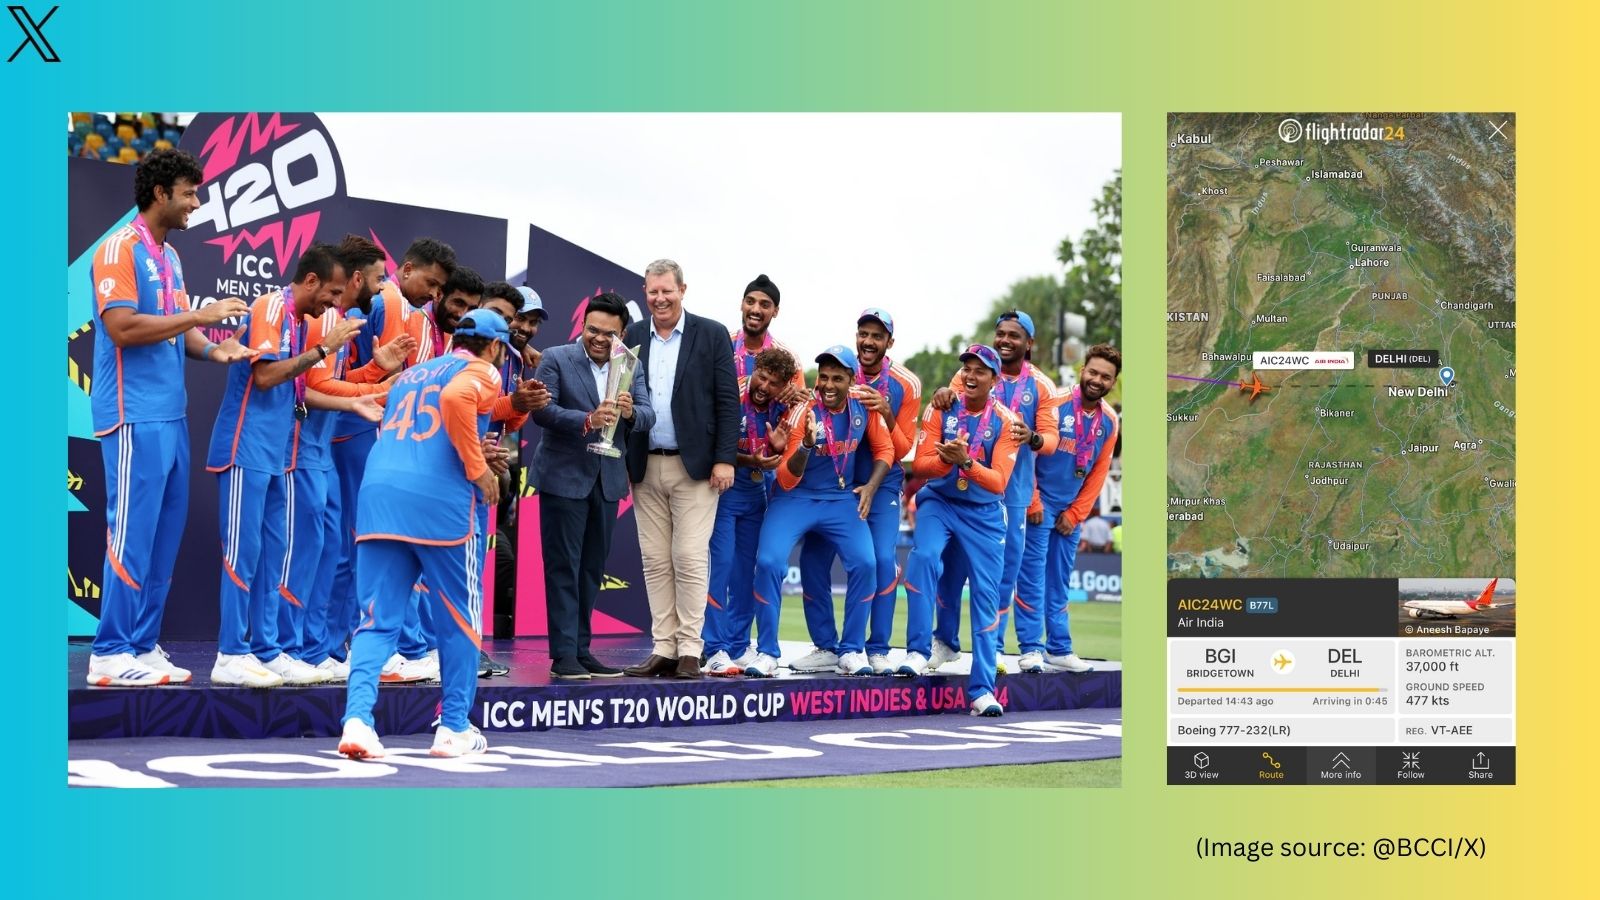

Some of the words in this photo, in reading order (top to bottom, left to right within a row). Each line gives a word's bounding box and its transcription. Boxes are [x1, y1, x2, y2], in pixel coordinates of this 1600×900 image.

[1177, 133, 1211, 144] Kabul
[1305, 122, 1405, 144] flightradar24
[1259, 157, 1304, 167] Peshawar
[1447, 153, 1471, 170] Indus
[1311, 169, 1363, 180] Islamabad
[1202, 186, 1228, 196] Khost
[1251, 191, 1268, 216] Indus
[1351, 243, 1402, 254] Gujranwala
[236, 253, 274, 279] ICC
[1355, 257, 1390, 267] Lahore
[1257, 272, 1306, 283] Faisalabad
[1371, 291, 1408, 300] PUNJAB
[1440, 301, 1494, 311] Chandigarh
[1167, 312, 1209, 322] KISTAN
[1256, 314, 1288, 323] Multan
[1202, 352, 1252, 362] Bahawalpu
[1260, 355, 1310, 366] AIC24WC
[1375, 354, 1407, 364] DELHI
[1408, 355, 1431, 364] (DEL)
[1388, 386, 1415, 397] New
[1417, 386, 1448, 397] Delhi
[383, 384, 441, 441] 45
[1320, 408, 1355, 418] Bikaner
[1493, 400, 1516, 418] Gang
[1167, 412, 1198, 422] Sukkur
[1408, 443, 1439, 455] Jaipur
[1453, 440, 1477, 452] Agra
[1308, 460, 1363, 469] RAJASTHAN
[1310, 476, 1349, 487] Jodhpur
[1170, 497, 1201, 507] Mirpur
[1203, 497, 1226, 506] Khas
[1167, 511, 1204, 521] erabad
[1333, 541, 1369, 553] Udaipur
[1177, 598, 1243, 612] AIC24WC
[1249, 600, 1274, 610] B77L
[1177, 617, 1194, 628] Air
[1196, 617, 1224, 628] India
[1204, 648, 1237, 664] BGI
[1327, 648, 1363, 664] DEL
[1405, 648, 1472, 658] BAROMETRIC
[1473, 648, 1496, 658] ALT.
[1405, 661, 1447, 674] 37,000
[1449, 661, 1460, 673] ft
[1186, 668, 1254, 679] BRIDGETOWN
[1330, 668, 1361, 679] DELHI
[1405, 682, 1450, 692] GROUND
[1452, 682, 1485, 692] SPEED
[1177, 696, 1223, 708] Departed
[1225, 697, 1254, 706] 14:43
[1255, 698, 1274, 708] ago
[1312, 696, 1351, 708] Arriving
[1352, 696, 1363, 706] in
[1365, 697, 1388, 706] 0:45
[1405, 694, 1429, 707] 477
[1431, 694, 1450, 707] kts
[482, 700, 525, 729] ICC
[531, 698, 605, 728] MEN'S
[609, 698, 650, 724] T20
[655, 694, 738, 722] WORLD
[743, 692, 785, 717] CUP
[790, 688, 846, 716] WEST
[849, 687, 913, 713] INDIES
[915, 688, 928, 710] &
[931, 686, 967, 709] USA
[1177, 725, 1217, 738] Boeing
[1218, 725, 1291, 738] 777-232(LR)
[1405, 727, 1428, 736] REG.
[1430, 725, 1473, 736] VT-AEE
[1184, 770, 1198, 780] 3D
[1198, 770, 1219, 780] view
[1259, 770, 1284, 780] Route
[1320, 770, 1342, 780] More
[1342, 769, 1362, 780] info
[1397, 770, 1425, 780] Follow
[1468, 770, 1493, 780] Share
